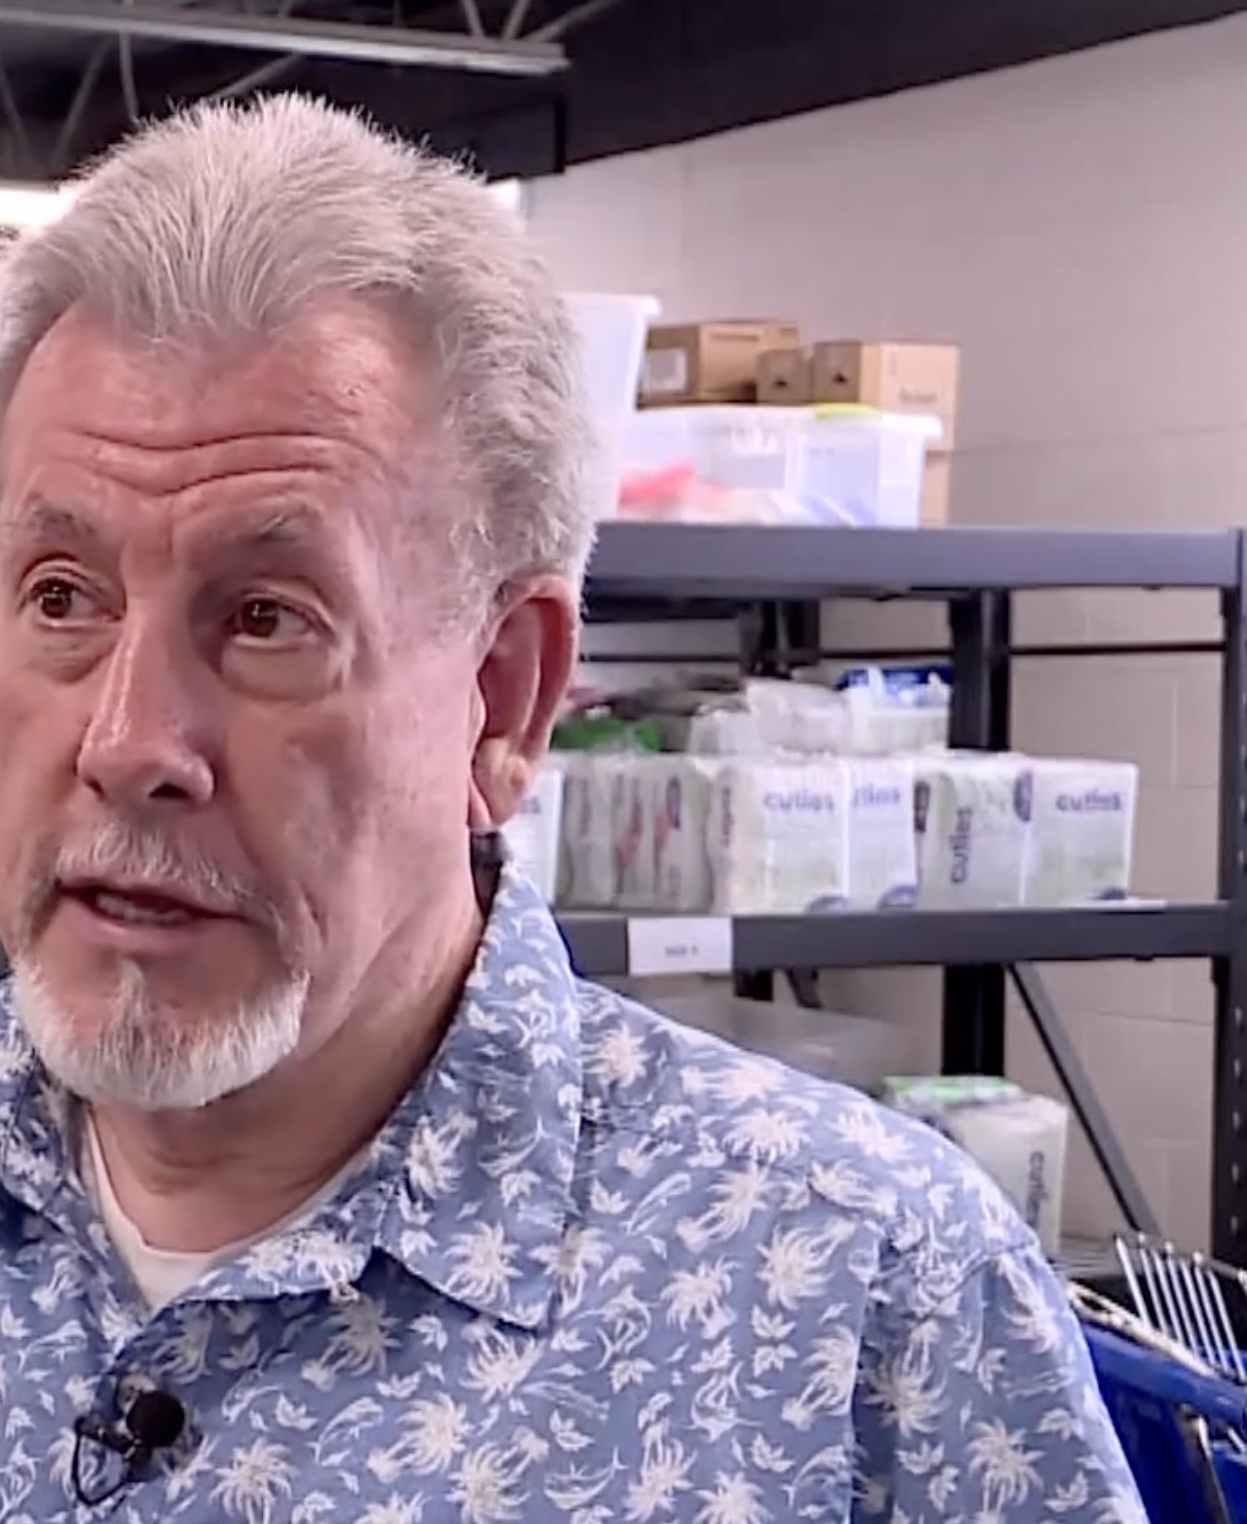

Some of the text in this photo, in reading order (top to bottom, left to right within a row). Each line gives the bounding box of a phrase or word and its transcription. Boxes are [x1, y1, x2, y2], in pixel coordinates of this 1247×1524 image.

[764, 789, 835, 813] cuties
[1055, 790, 1122, 812] cuties
[949, 807, 972, 884] cuties
